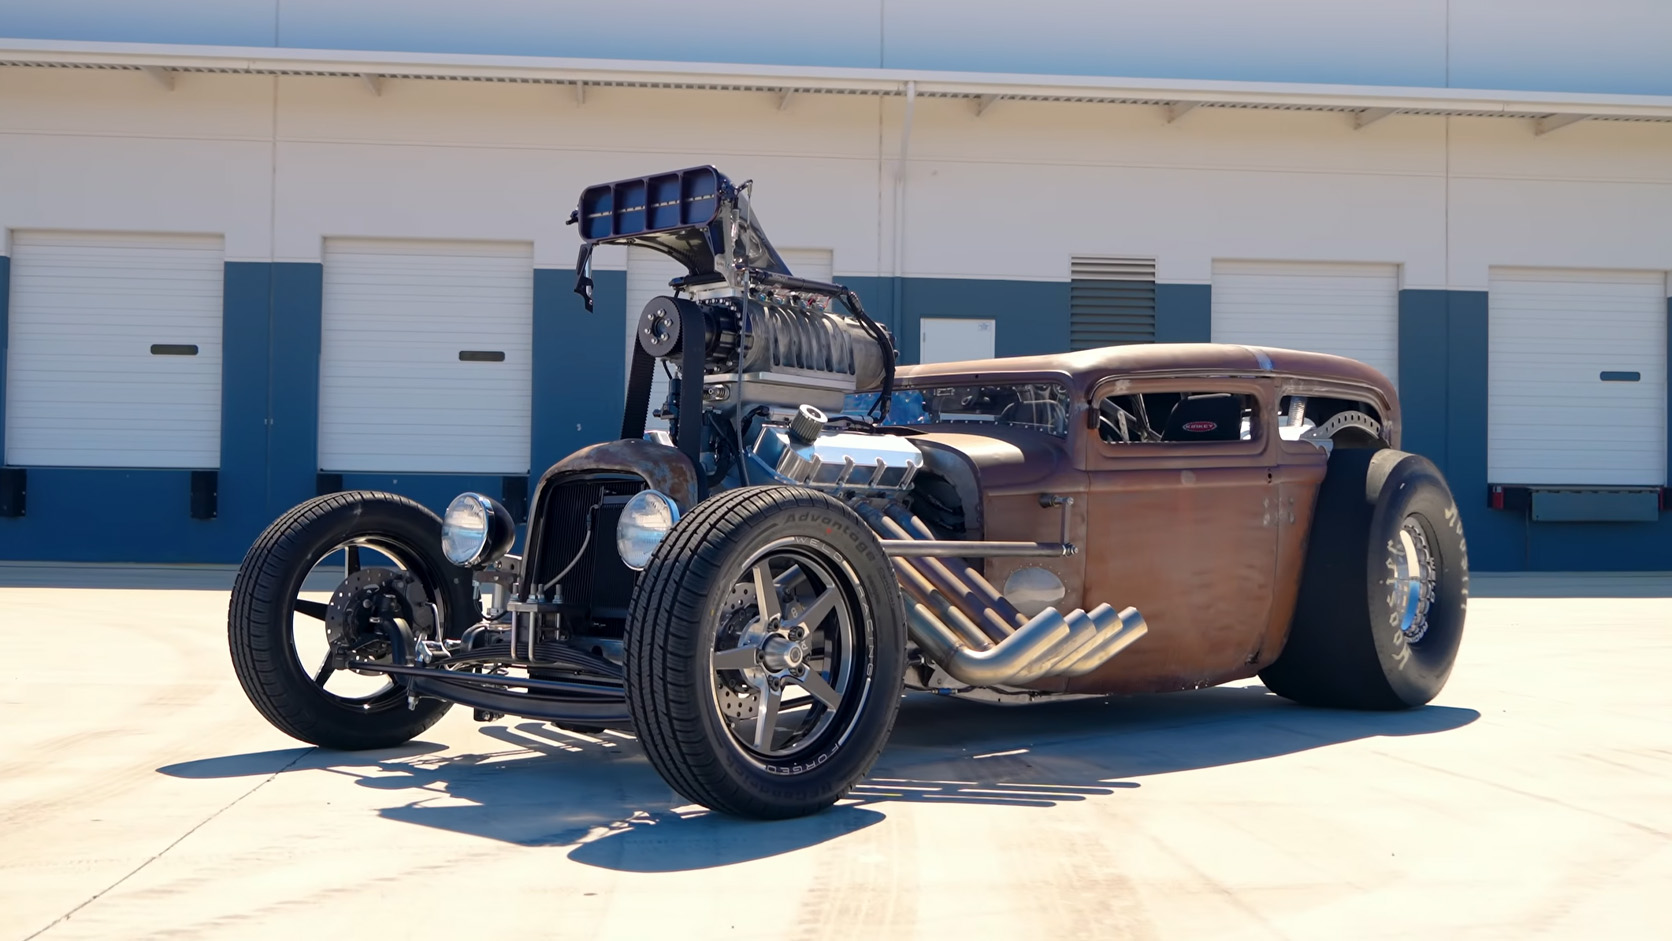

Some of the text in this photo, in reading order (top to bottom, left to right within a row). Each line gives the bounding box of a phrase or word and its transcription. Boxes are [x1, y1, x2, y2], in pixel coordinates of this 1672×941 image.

[784, 511, 877, 562] Advantage
[794, 536, 843, 562] WELD
[858, 585, 875, 678] RACING
[766, 743, 840, 776] FORGED
